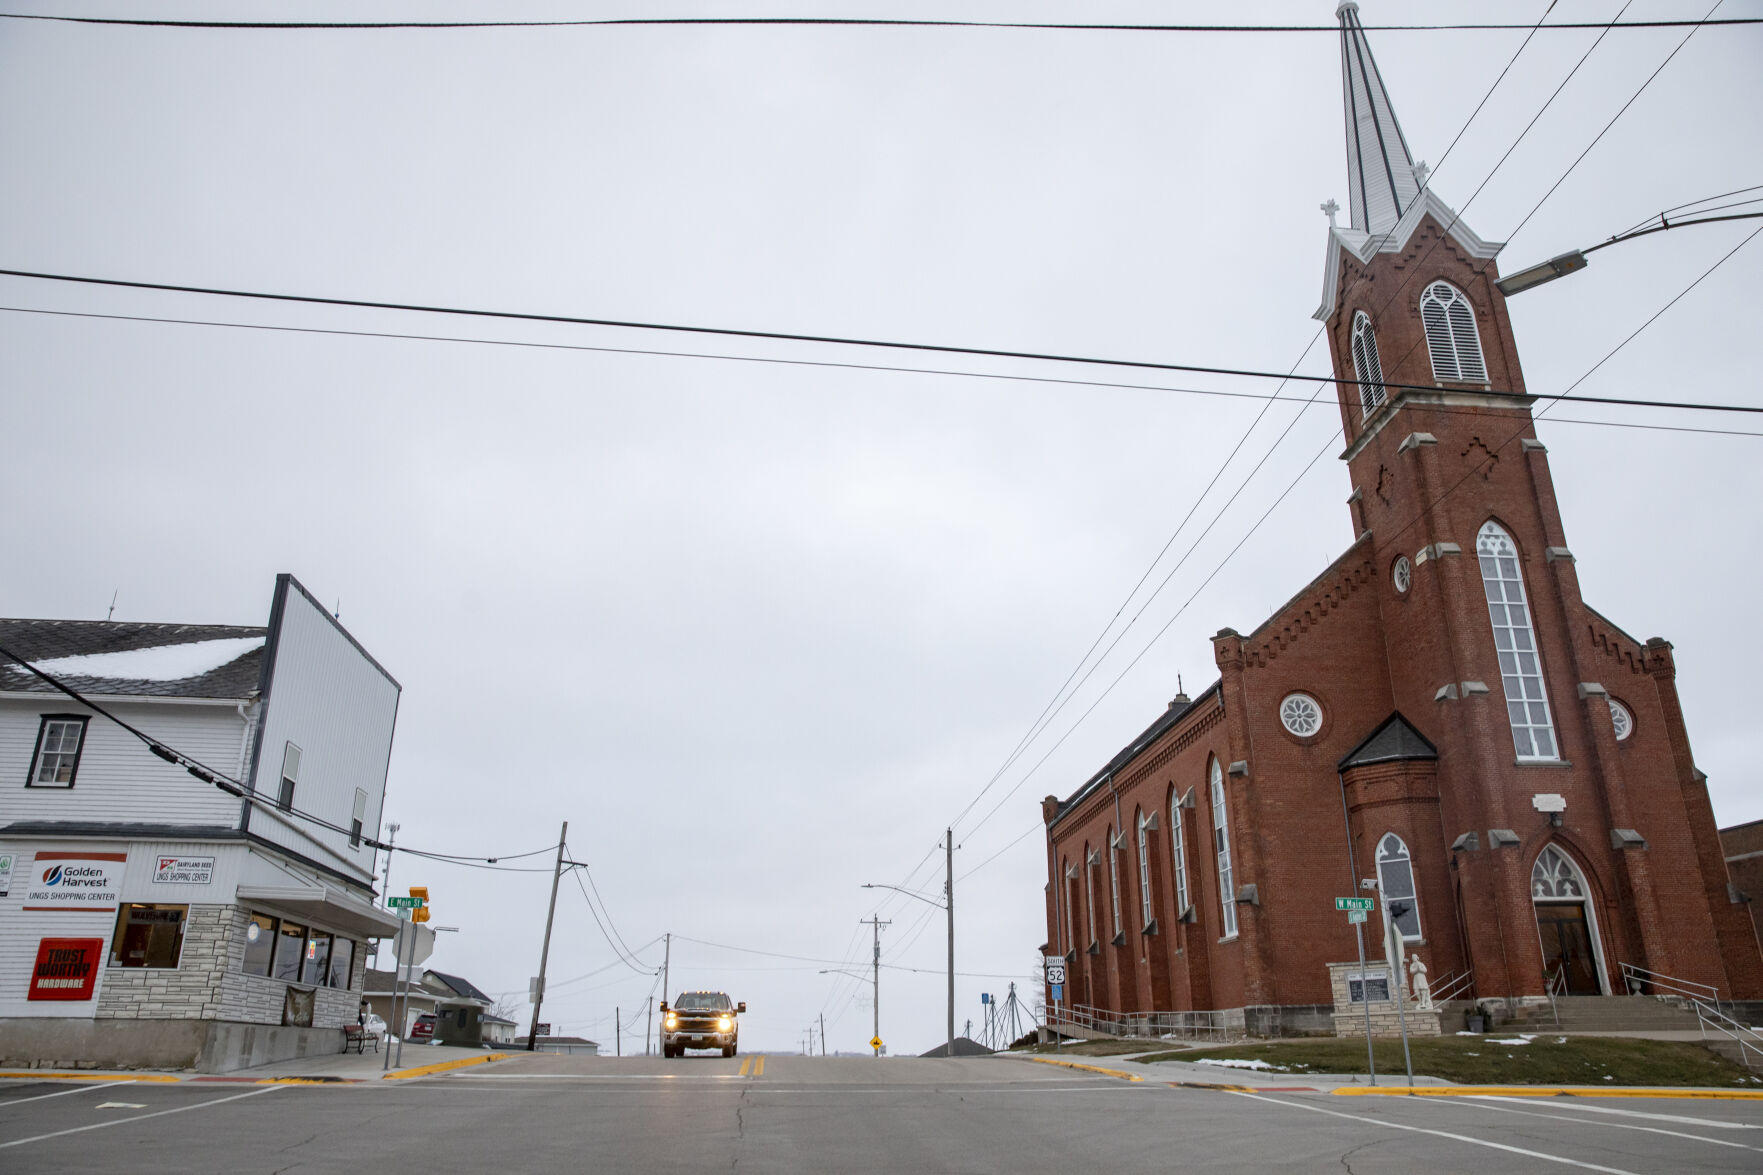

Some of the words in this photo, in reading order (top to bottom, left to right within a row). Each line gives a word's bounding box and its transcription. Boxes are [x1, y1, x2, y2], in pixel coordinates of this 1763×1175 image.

[64, 867, 103, 876] Golden
[62, 877, 107, 887] Harvest
[170, 873, 191, 881] SHOPPING
[191, 873, 209, 882] CENTER
[29, 892, 49, 900] UNGS
[50, 892, 86, 901] SHOPPING
[87, 893, 116, 901] CENTER
[390, 898, 394, 906] E
[397, 898, 411, 907] Main
[413, 898, 420, 907] St
[1338, 899, 1344, 908] W
[1346, 899, 1363, 909] Main
[1364, 899, 1372, 909] St
[48, 949, 88, 964] TRUST
[37, 963, 91, 977] WORTHY
[1050, 970, 1062, 981] 52
[37, 979, 85, 989] HARDWARE
